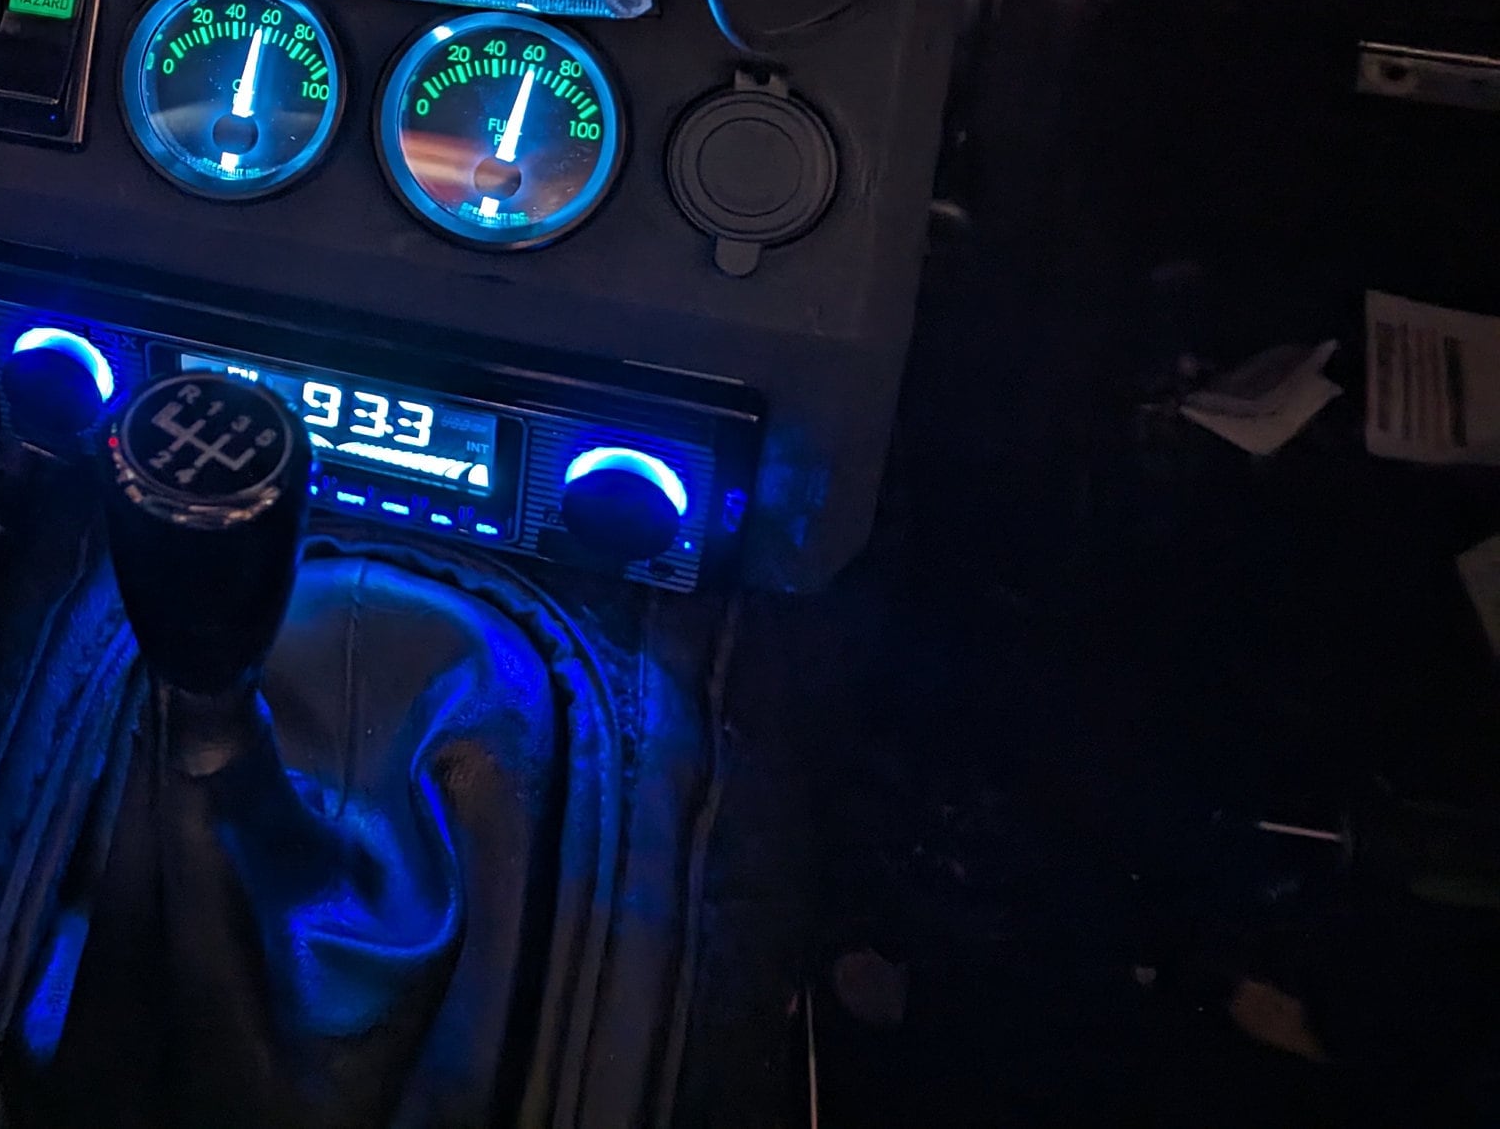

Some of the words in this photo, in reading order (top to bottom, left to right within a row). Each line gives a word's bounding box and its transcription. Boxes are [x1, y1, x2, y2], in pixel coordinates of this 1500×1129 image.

[192, 7, 214, 25] 20
[225, 3, 246, 20] 40
[261, 9, 282, 26] 60
[294, 23, 315, 41] 80
[447, 44, 471, 62] 20
[483, 39, 507, 57] 40
[522, 45, 546, 62] 60
[162, 58, 175, 75] 0
[559, 60, 582, 78] 80
[302, 81, 330, 100] 100
[416, 99, 430, 116] 0
[569, 120, 600, 140] 100
[177, 383, 201, 404] R
[302, 381, 434, 448] 93.3
[466, 440, 489, 454] INT
